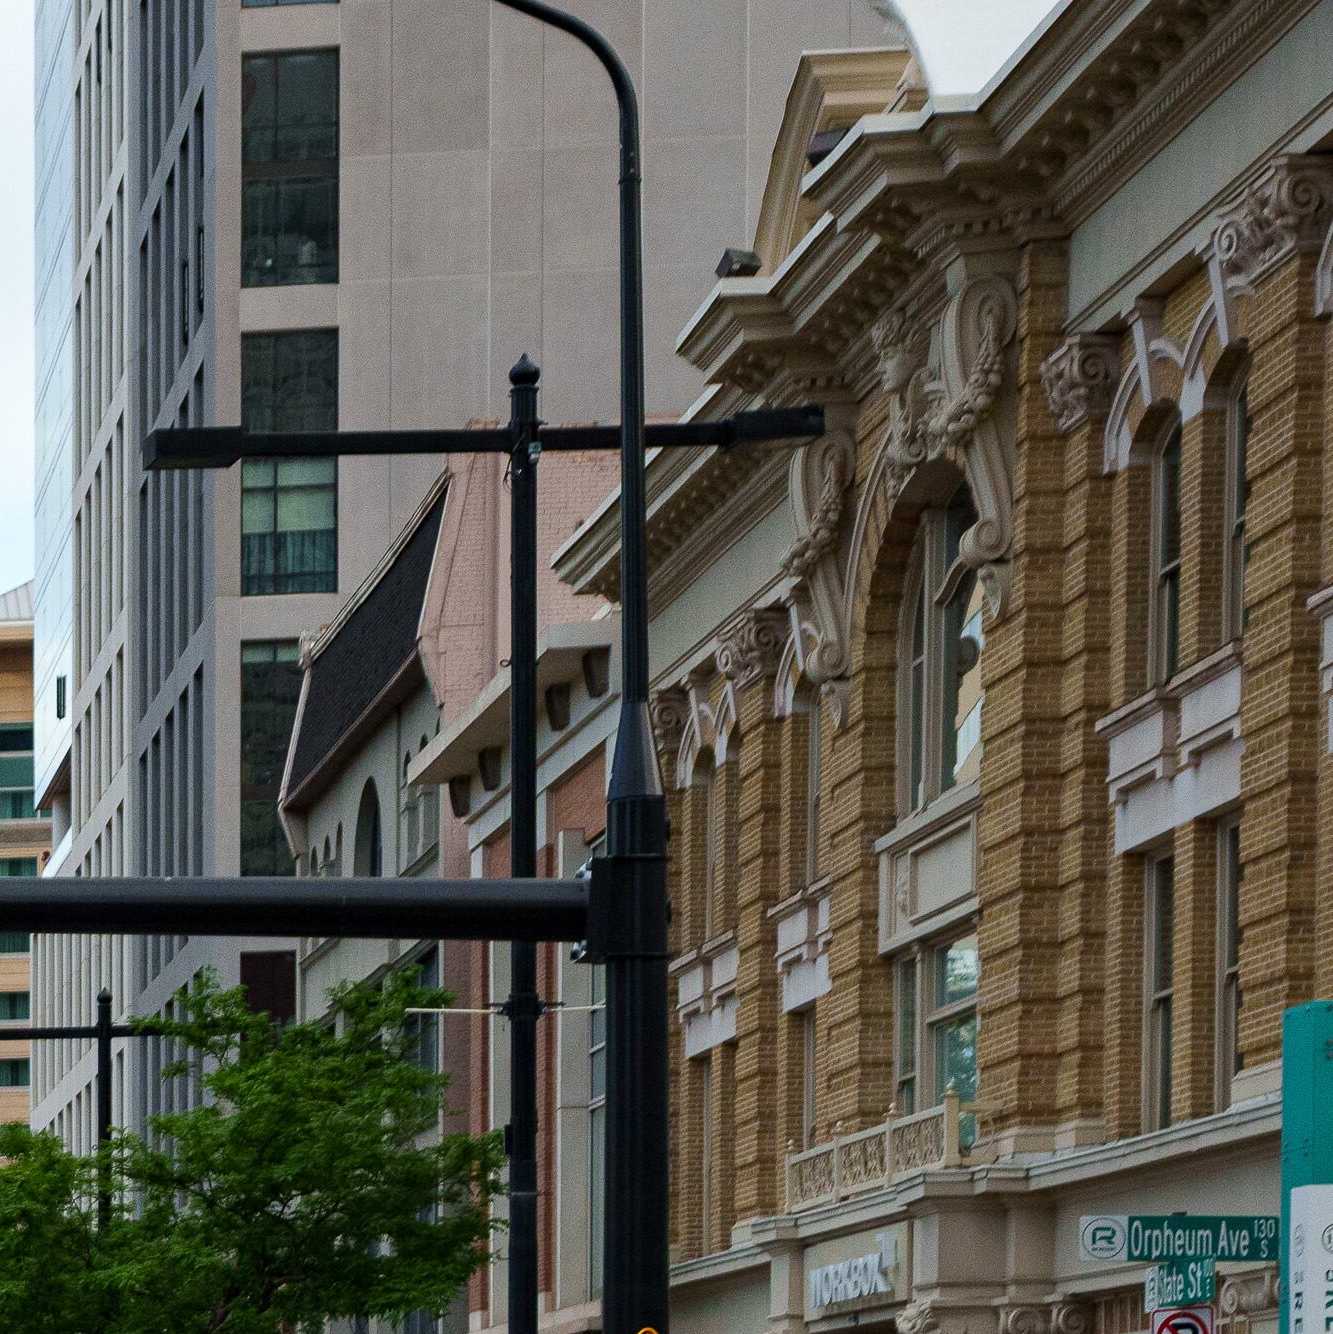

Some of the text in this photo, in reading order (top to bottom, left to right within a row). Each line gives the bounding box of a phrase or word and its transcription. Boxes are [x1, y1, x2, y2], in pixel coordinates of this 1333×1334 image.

[1132, 1219, 1213, 1260] Orpheum
[1217, 1219, 1250, 1257] Ave
[1254, 1219, 1276, 1239] 130
[1259, 1239, 1269, 1258] S
[1187, 1261, 1202, 1299] St
